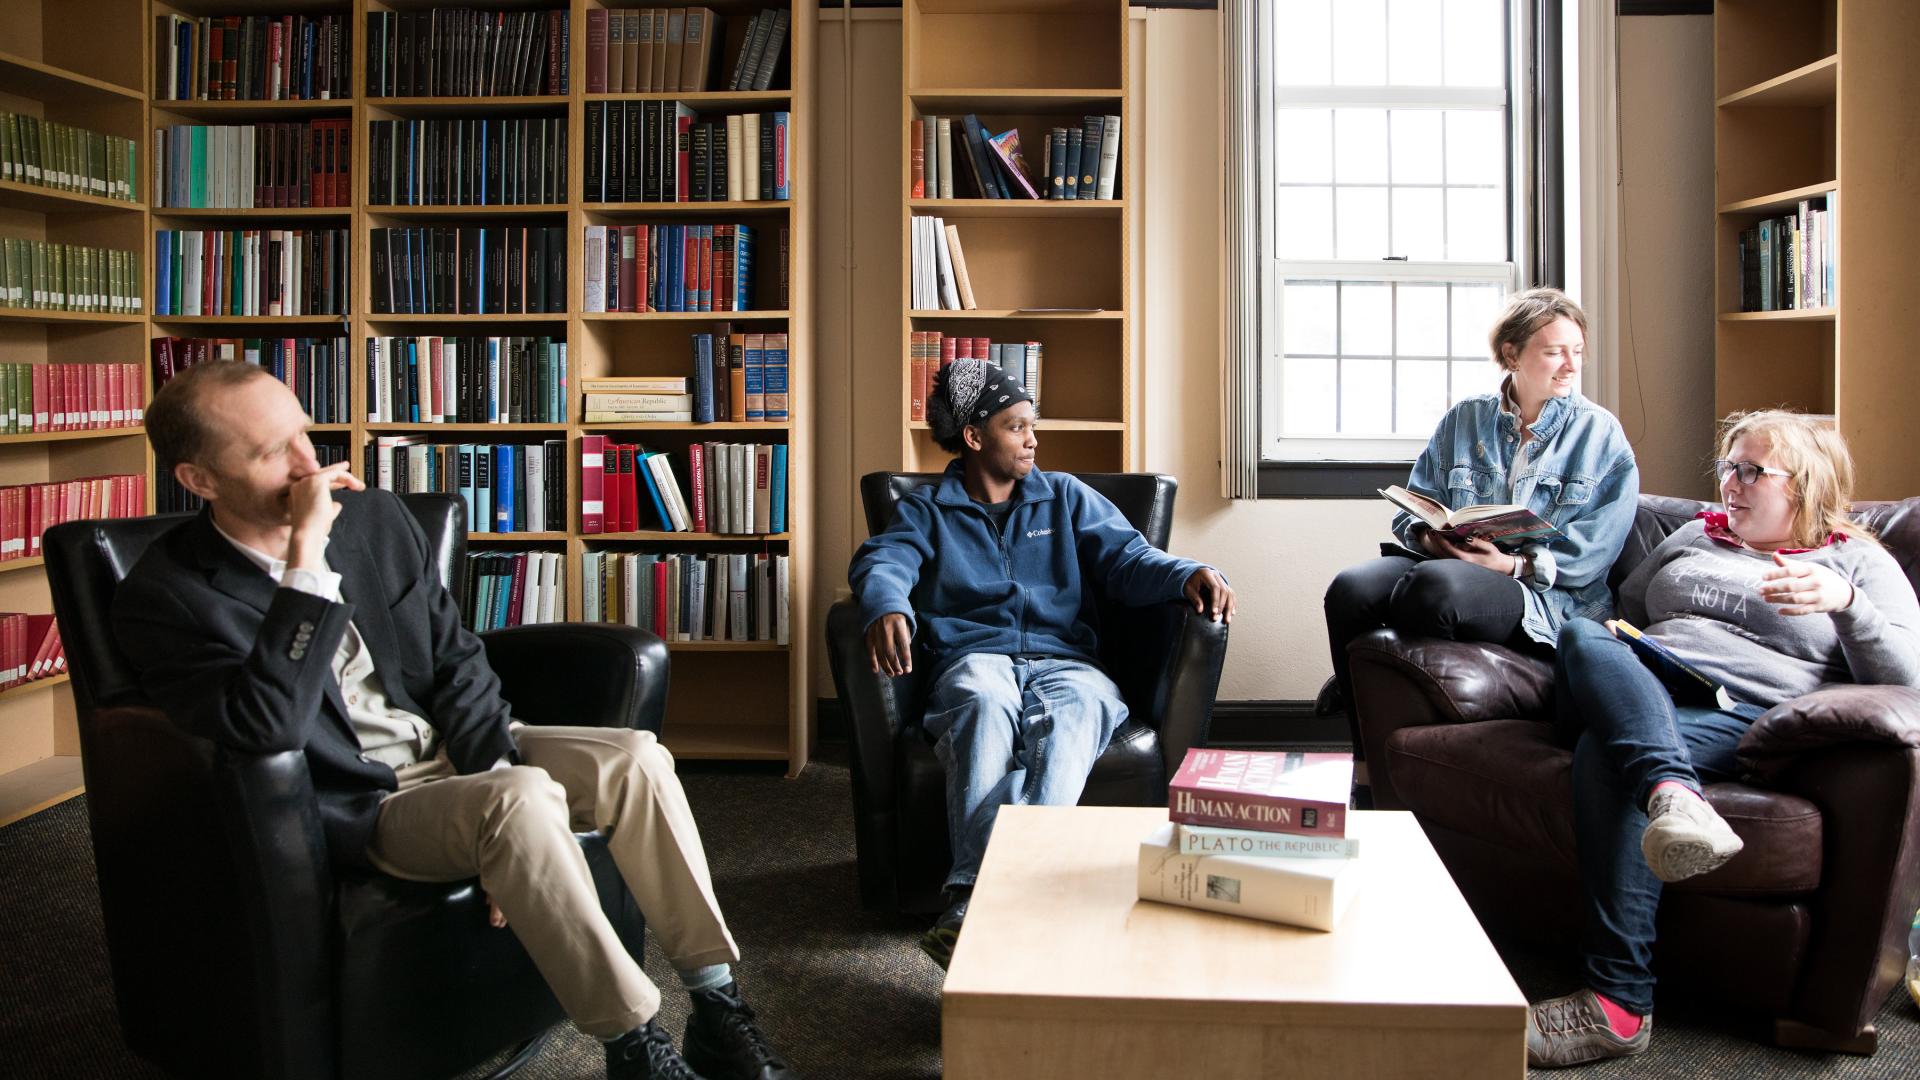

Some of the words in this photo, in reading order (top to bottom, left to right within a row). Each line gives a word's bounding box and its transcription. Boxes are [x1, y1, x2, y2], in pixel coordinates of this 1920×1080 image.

[1691, 584, 1736, 611] NOT
[1732, 593, 1747, 619] A
[1176, 791, 1234, 817] HUMAN
[1235, 805, 1292, 823] ACTION
[1189, 834, 1254, 852] PLATO
[1259, 840, 1281, 851] THE
[1284, 841, 1340, 853] REPUBLIC
